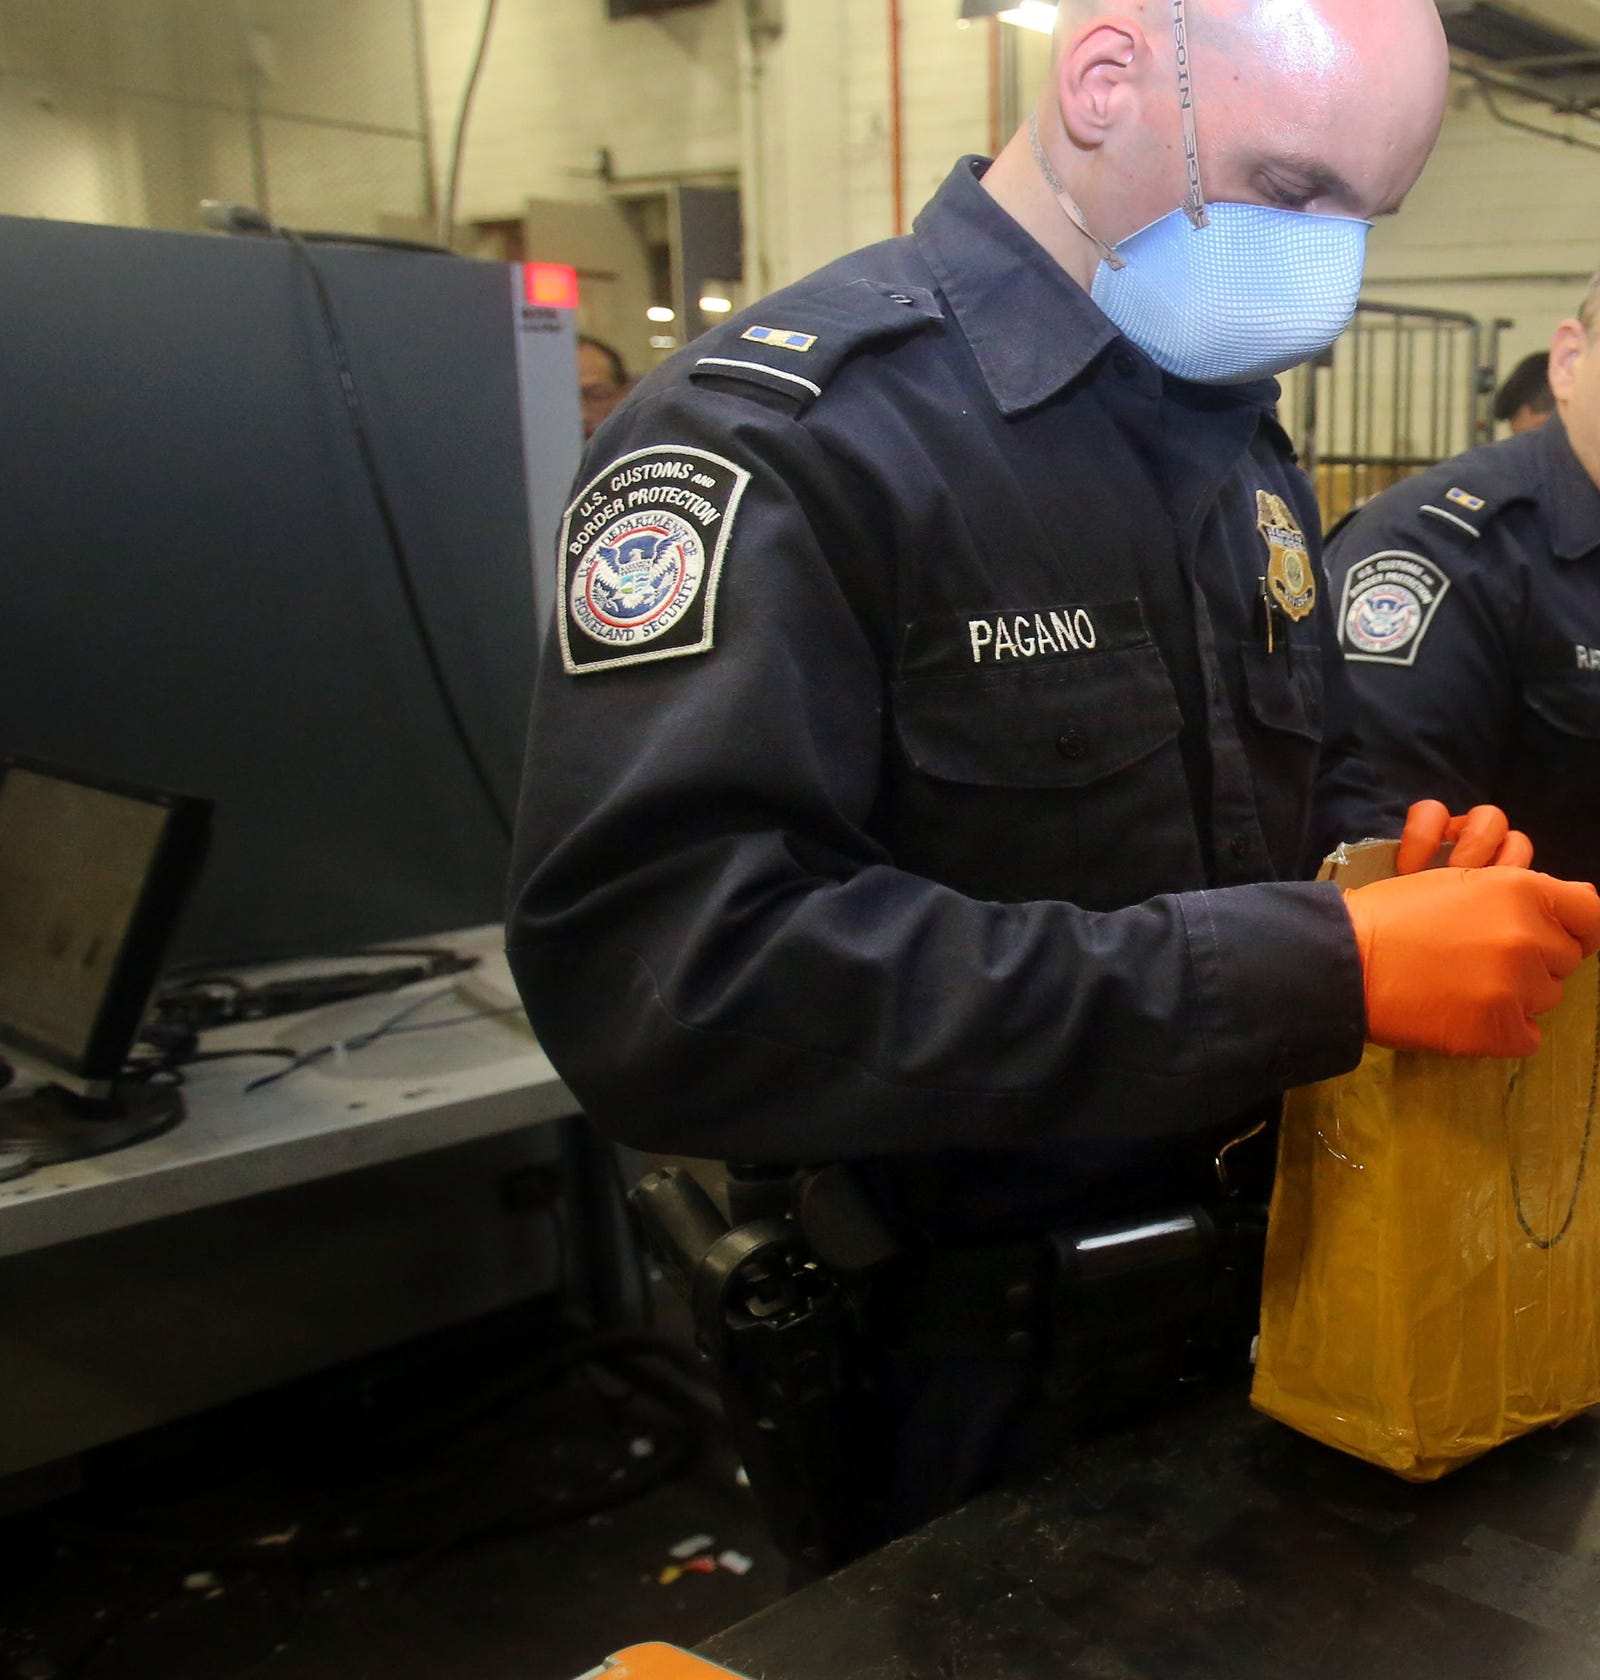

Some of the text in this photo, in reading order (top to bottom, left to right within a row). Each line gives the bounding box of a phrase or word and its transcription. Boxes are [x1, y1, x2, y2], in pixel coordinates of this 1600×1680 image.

[580, 461, 716, 518] U.S. CUSTOMS AND
[569, 486, 721, 556] BORDER PROTECTION
[601, 515, 688, 546] DEPARTMENT
[683, 538, 697, 557] OF
[574, 573, 697, 642] HOMELAND SECURITY
[968, 608, 1097, 663] PAGANO
